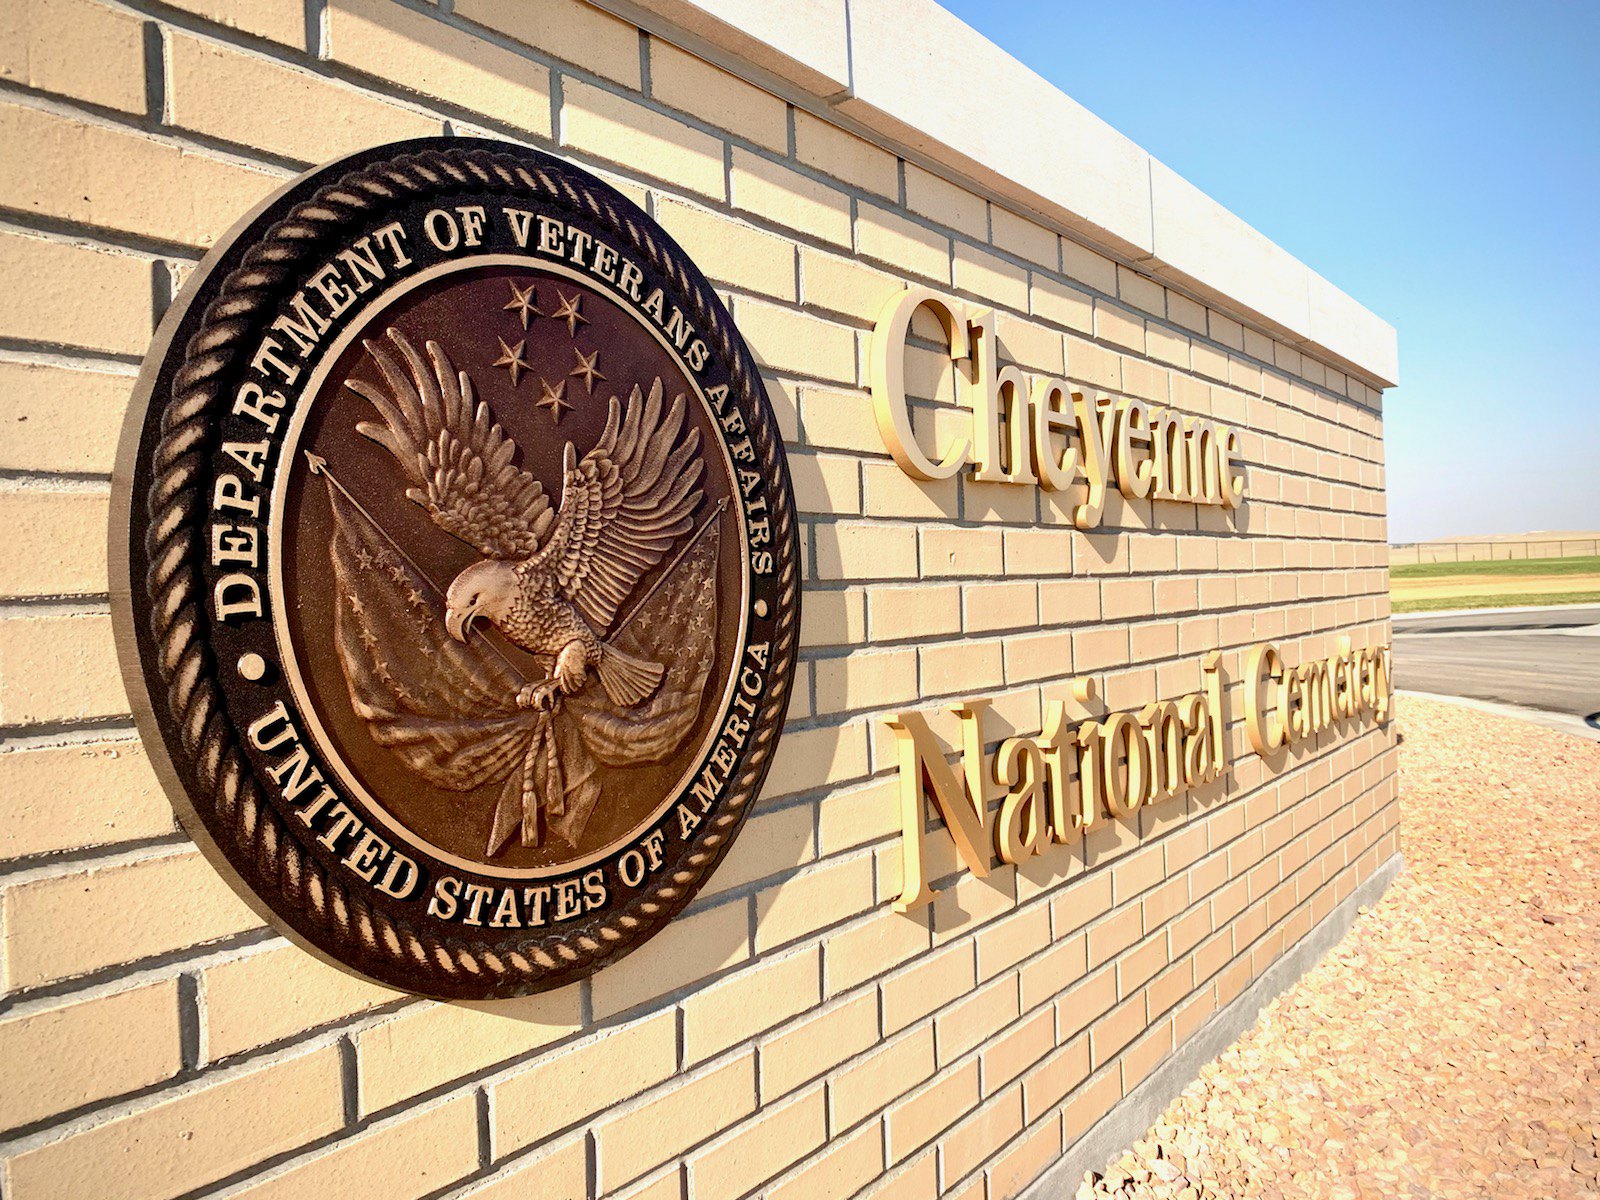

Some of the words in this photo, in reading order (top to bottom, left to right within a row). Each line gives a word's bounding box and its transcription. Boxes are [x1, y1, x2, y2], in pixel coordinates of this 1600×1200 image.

[211, 225, 412, 622] DEPARTMENT
[424, 205, 489, 251] OF
[501, 208, 710, 374] VETERANS
[704, 383, 773, 577] AFFAIRS
[871, 286, 1245, 529] Cheyenne
[246, 701, 422, 899] UNITED
[426, 869, 609, 929] STATES
[617, 834, 665, 888] OF
[677, 640, 770, 841] AMERICA
[884, 650, 1225, 912] National
[1244, 636, 1392, 758] Cemetery
